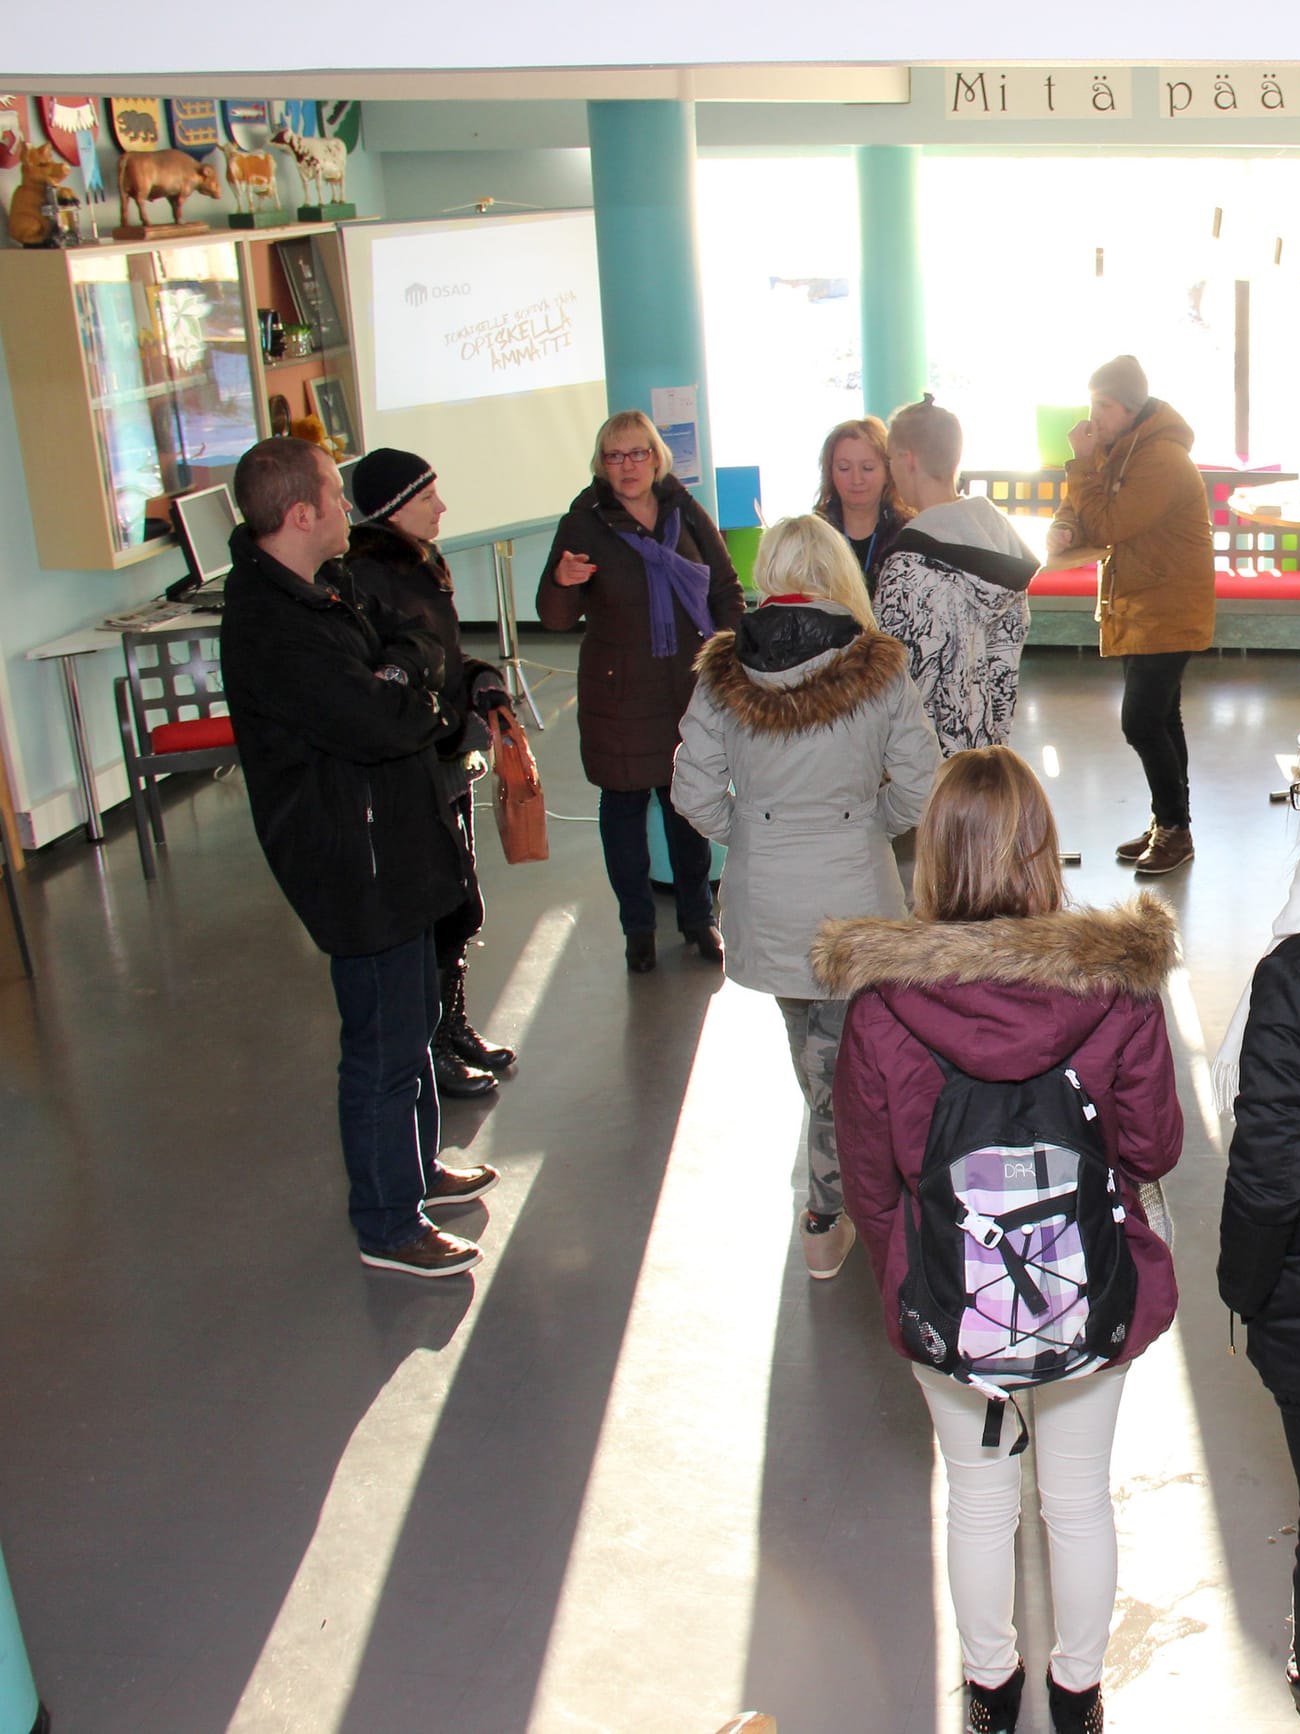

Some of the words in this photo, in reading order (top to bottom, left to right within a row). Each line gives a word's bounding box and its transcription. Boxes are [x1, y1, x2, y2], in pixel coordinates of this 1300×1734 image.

[952, 72, 1116, 112] Mitä
[432, 283, 471, 298] OSAO
[460, 306, 571, 361] OPISKELLA
[490, 332, 572, 372] AMMATTI
